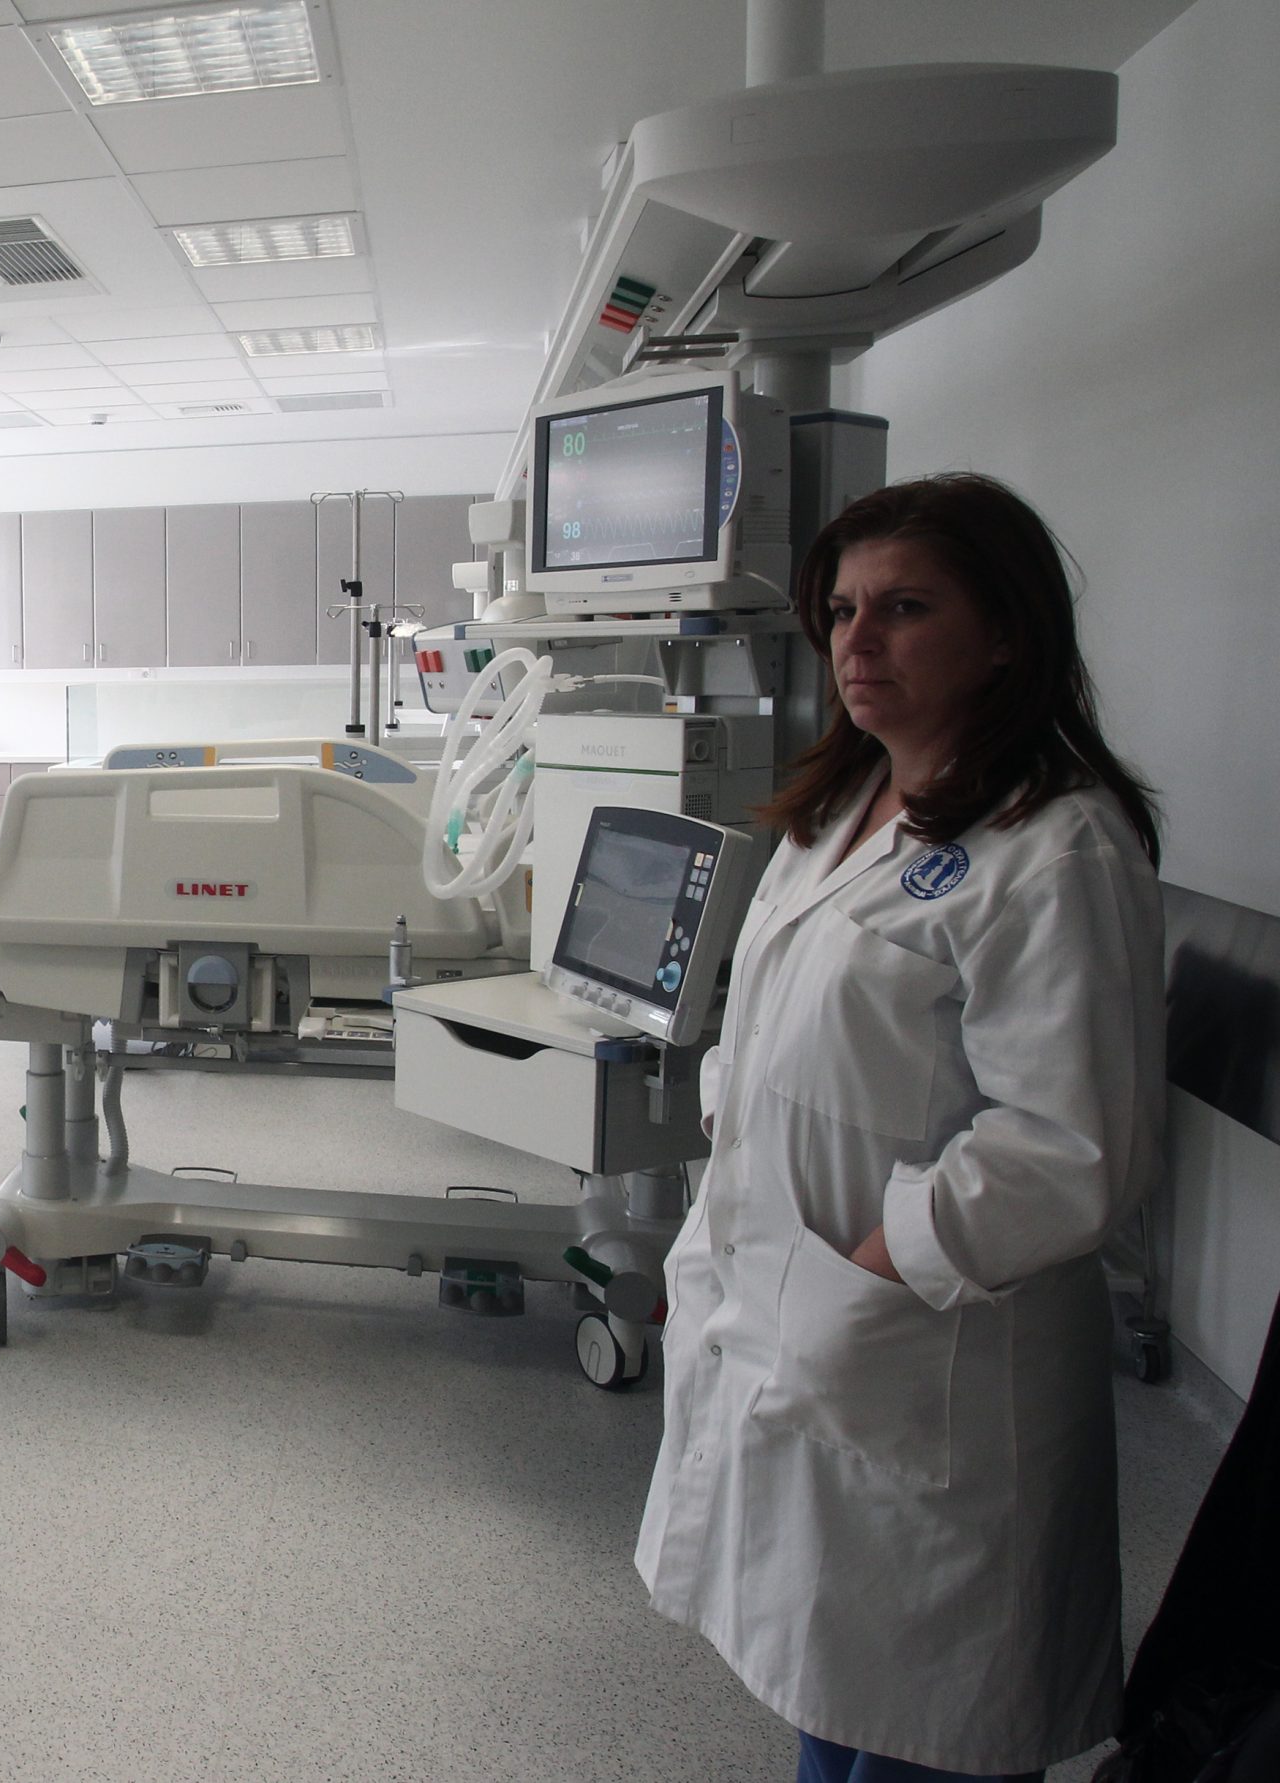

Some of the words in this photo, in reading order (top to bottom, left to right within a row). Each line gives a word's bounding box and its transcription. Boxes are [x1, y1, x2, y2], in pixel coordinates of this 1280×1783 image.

[562, 431, 586, 457] 80
[562, 521, 581, 540] 98
[580, 744, 627, 757] MAQUET
[176, 883, 249, 897] LINET
